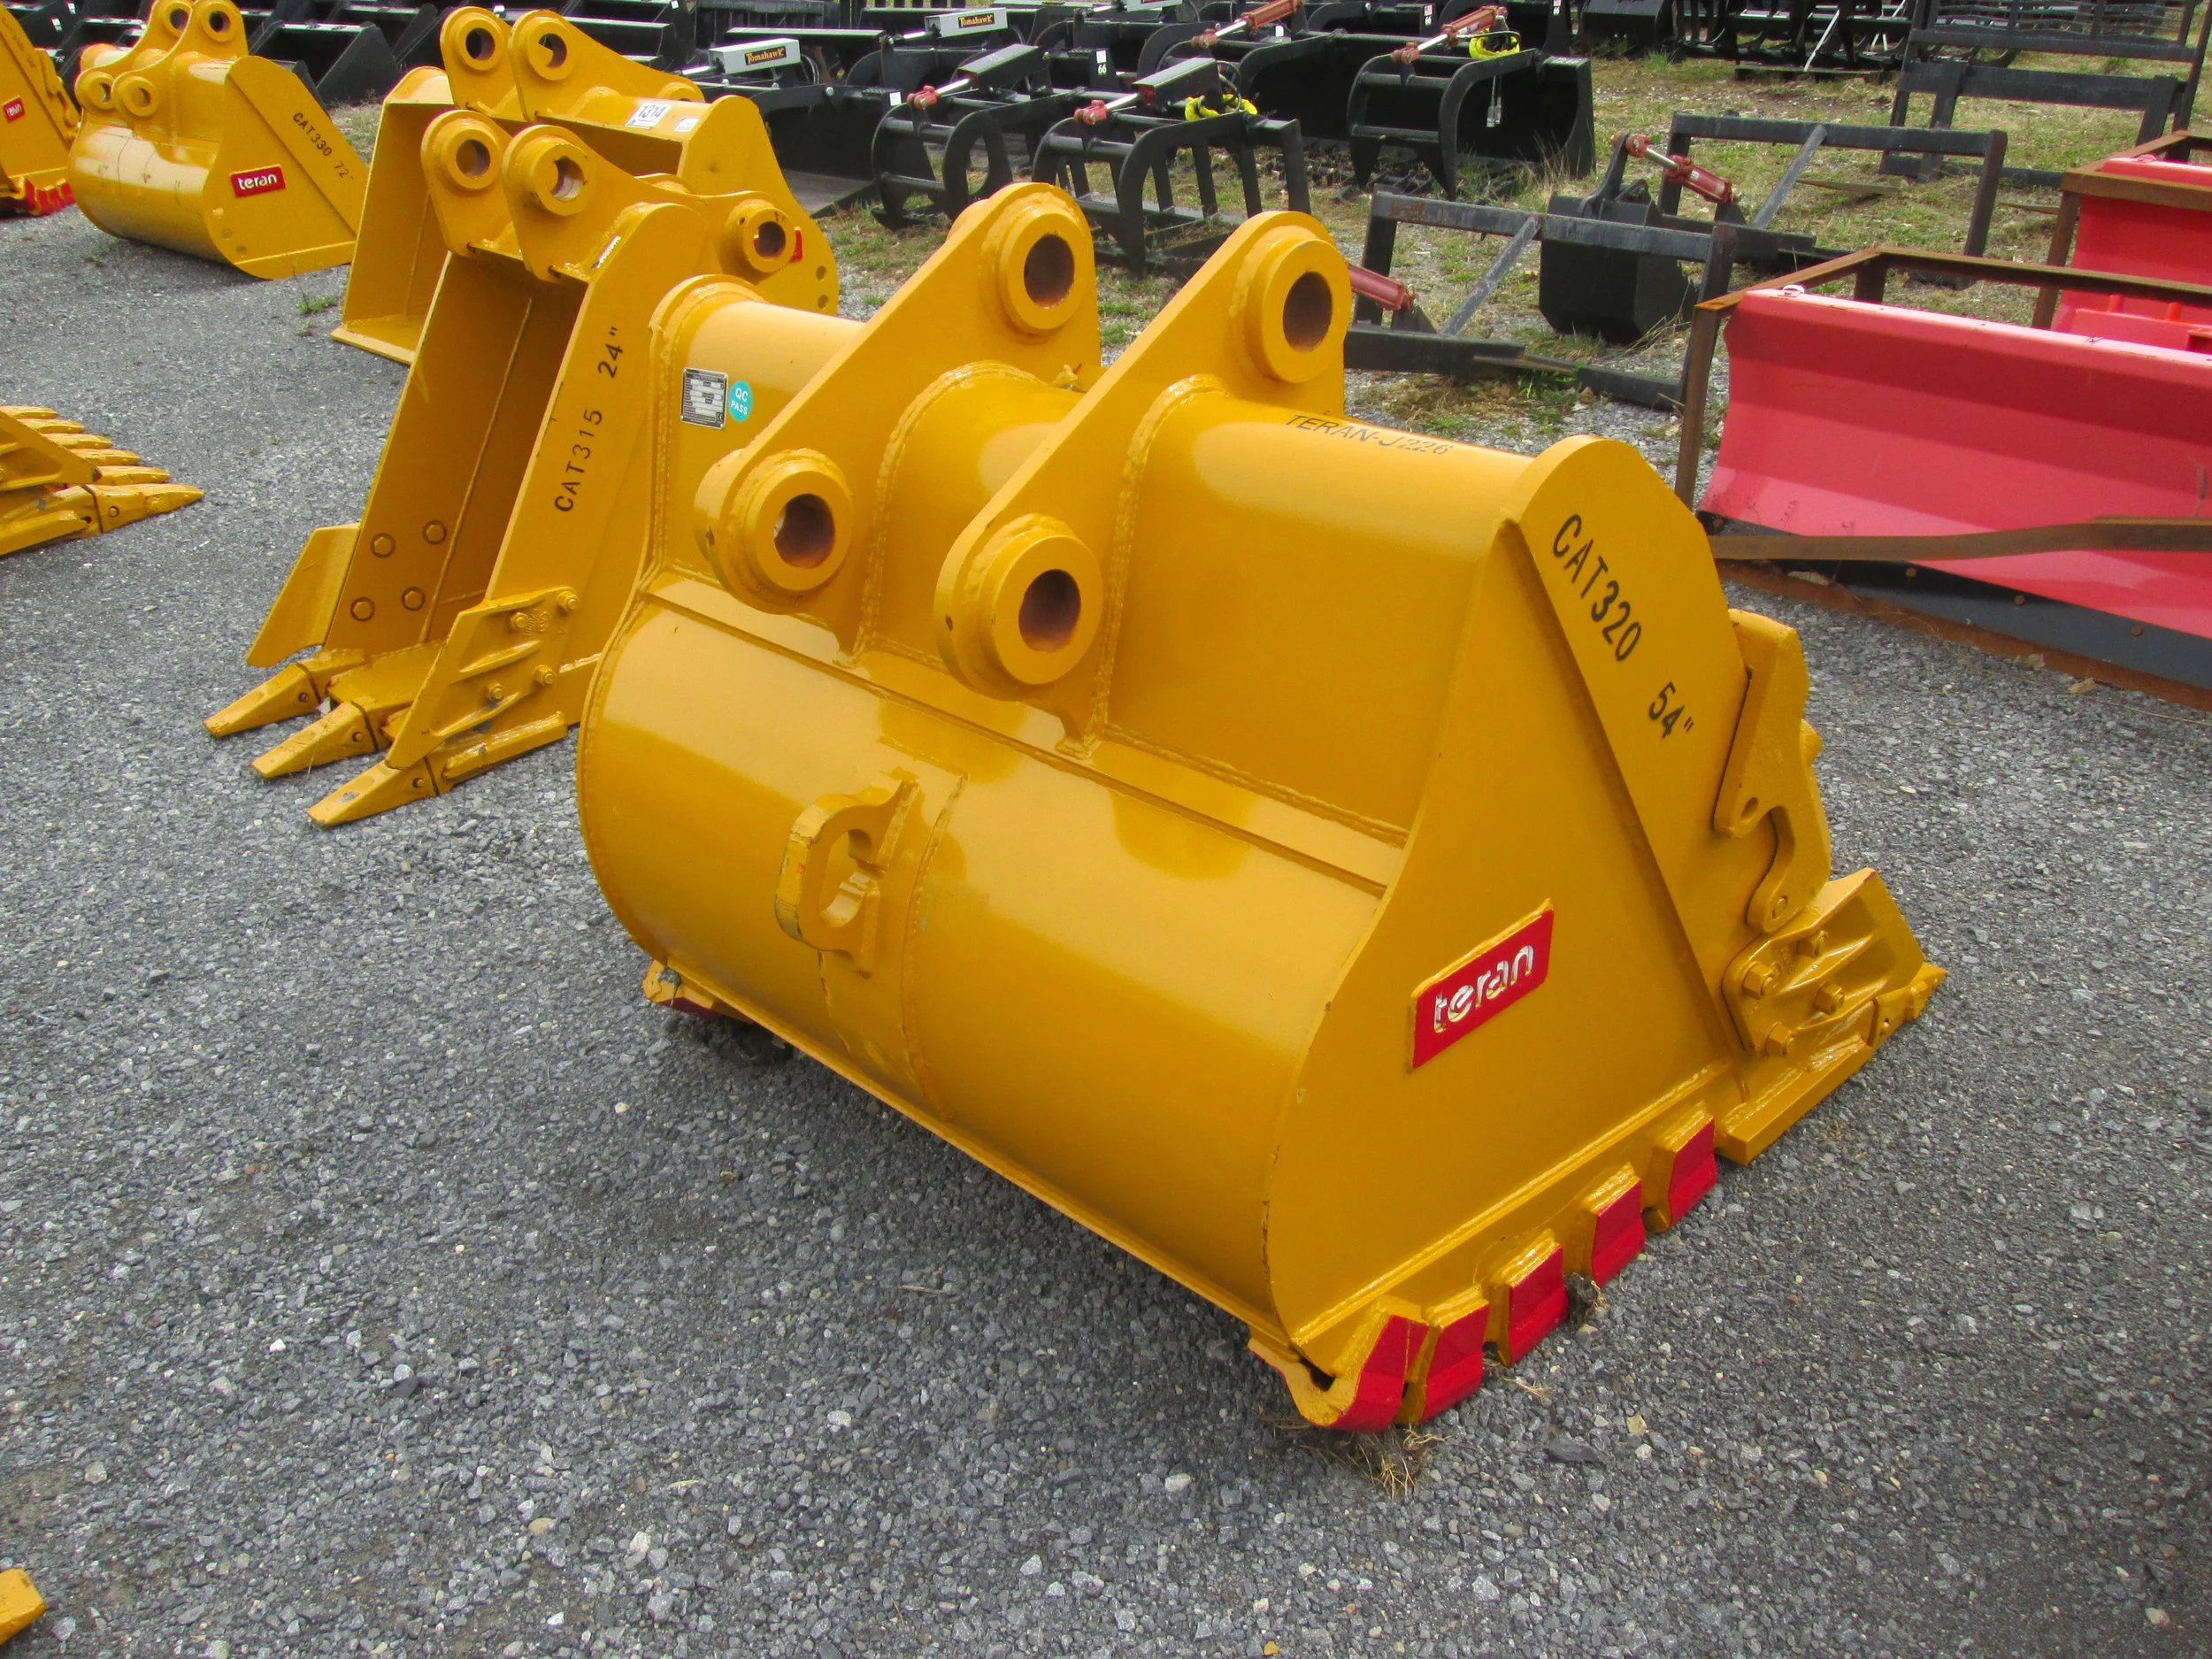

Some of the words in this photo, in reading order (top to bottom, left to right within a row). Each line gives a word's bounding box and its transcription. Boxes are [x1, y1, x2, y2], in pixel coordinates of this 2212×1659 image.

[959, 14, 993, 27] Tomahawk
[746, 47, 785, 65] Tomahawk
[1097, 64, 1107, 75] 66
[293, 112, 333, 157] CAT330
[237, 173, 277, 190] teran
[735, 388, 749, 403] QC
[731, 399, 748, 415] PASS
[554, 408, 603, 512] CAT315
[597, 326, 623, 379] 24"
[1552, 514, 1642, 662] CAT320
[1647, 680, 1694, 740] 54"
[1433, 944, 1534, 1033] teran
